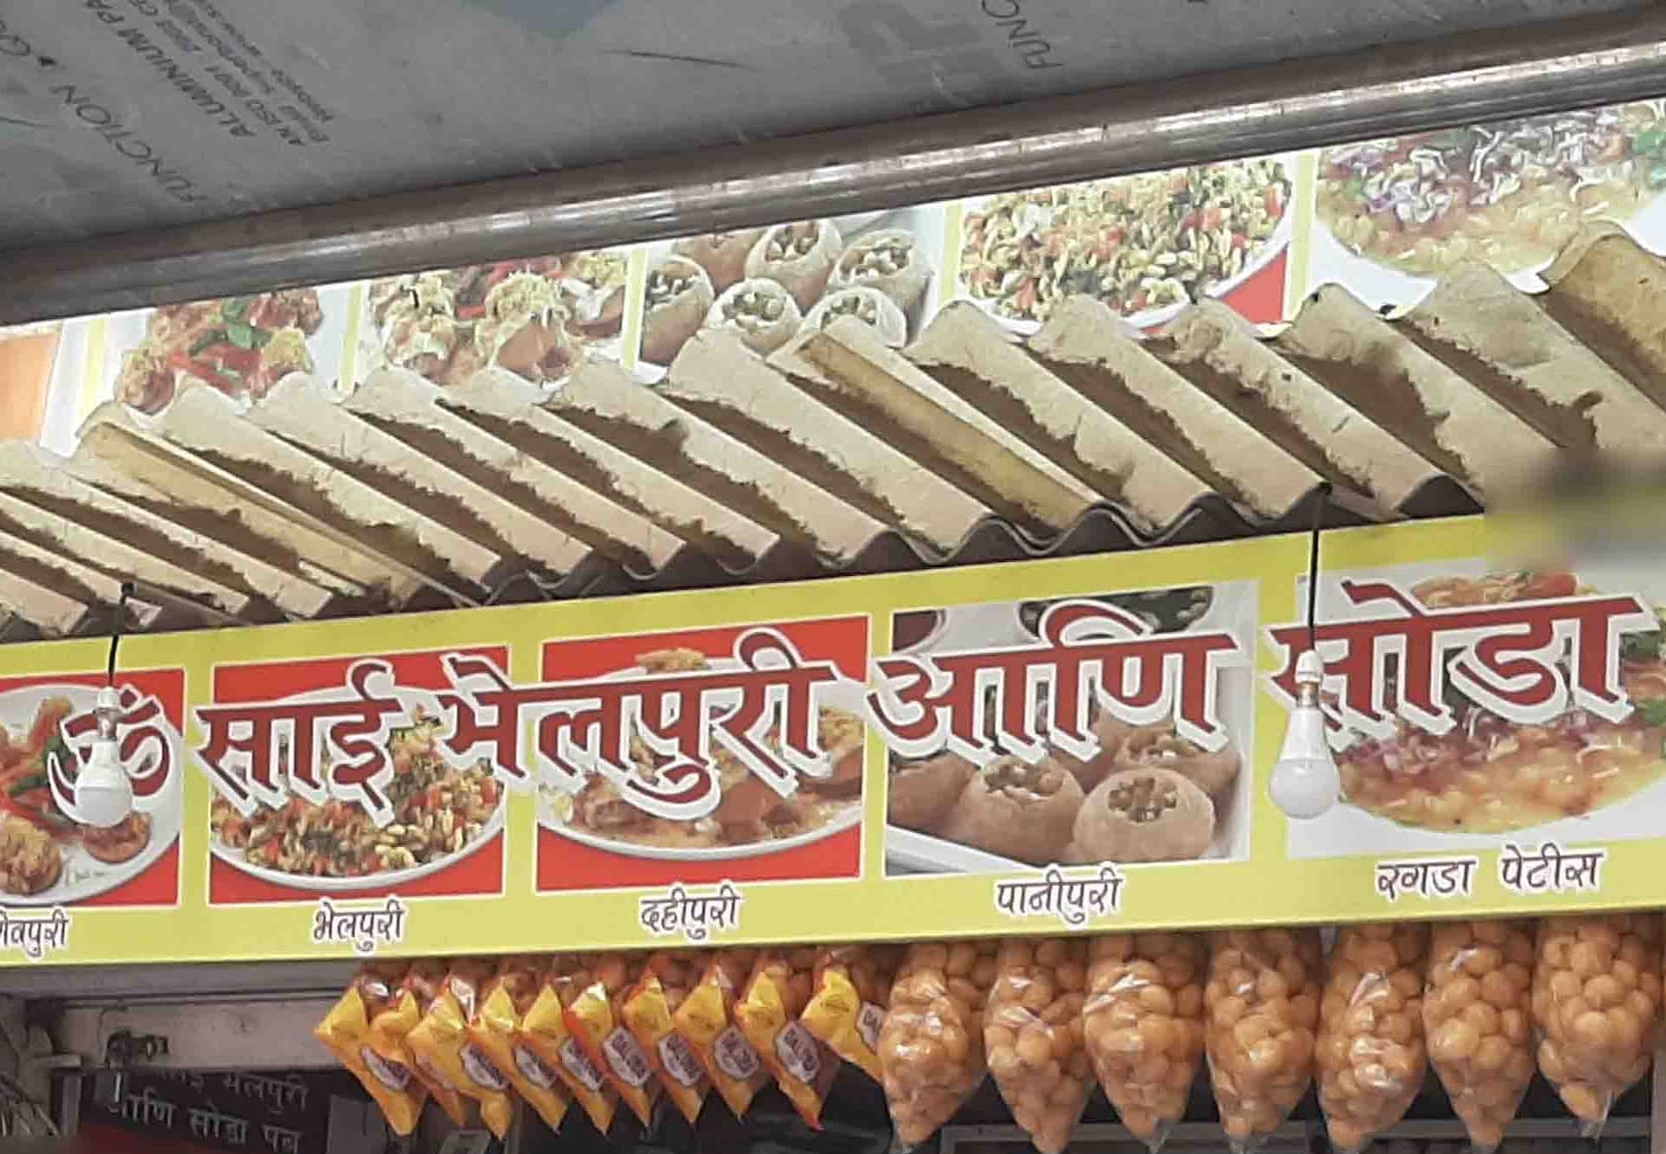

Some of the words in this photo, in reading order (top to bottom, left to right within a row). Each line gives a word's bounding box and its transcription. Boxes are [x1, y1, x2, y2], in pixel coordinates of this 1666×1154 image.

[115, 28, 257, 138] ALUMINIUM
[50, 83, 209, 203] FUNCTION
[195, 661, 402, 822] साई
[436, 626, 847, 820] भेलपुरी
[867, 599, 1242, 762] आणि
[1266, 577, 1645, 752] सोडा
[996, 869, 1123, 926] पानीपुरी
[1376, 859, 1476, 901] रगडा
[1499, 843, 1604, 890] पेटीस
[313, 899, 402, 951] भेलपुरी
[640, 882, 741, 938] दहीपुरी
[188, 1098, 251, 1144] सोडा
